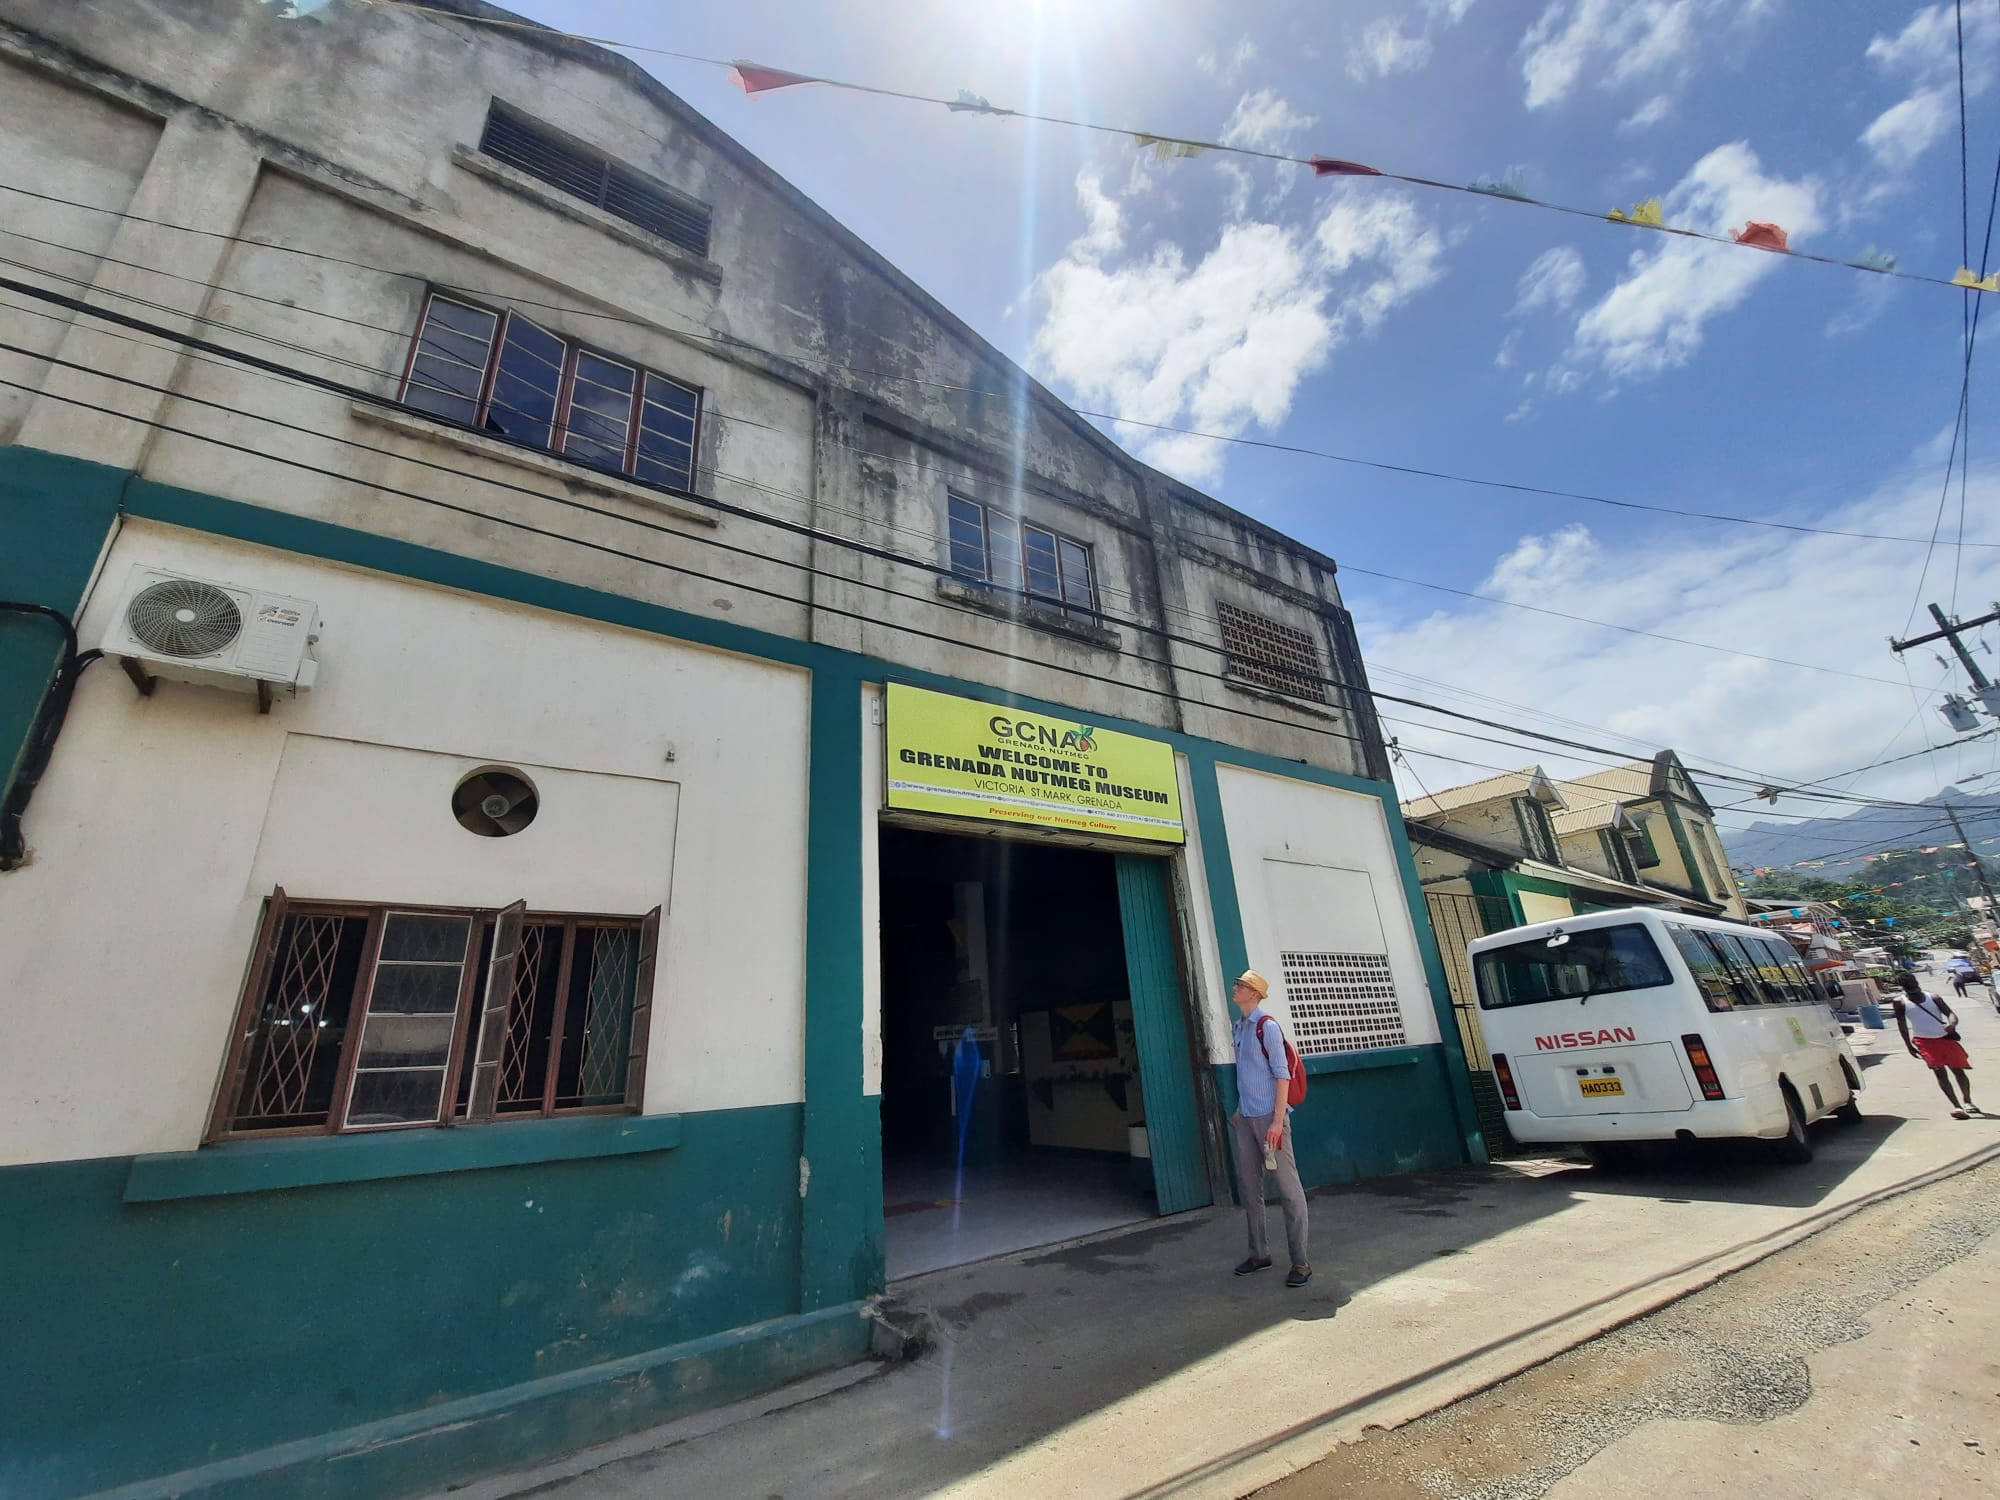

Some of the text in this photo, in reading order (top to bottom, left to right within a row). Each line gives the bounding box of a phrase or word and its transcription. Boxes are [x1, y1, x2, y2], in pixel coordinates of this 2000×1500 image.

[989, 716, 1080, 751] GCNA
[998, 738, 1089, 760] GRENADA NUTMEG
[899, 748, 1168, 804] GRENADA NUTMEG MUSEUM
[978, 744, 1108, 778] WELCOME TO
[974, 779, 1026, 796] VICTORIA
[1077, 795, 1122, 810] GRENADA
[989, 807, 1034, 820] Preserving
[1054, 815, 1087, 829] Nutmeg
[1089, 819, 1117, 831] Culture
[1532, 1026, 1636, 1050] NISSAN
